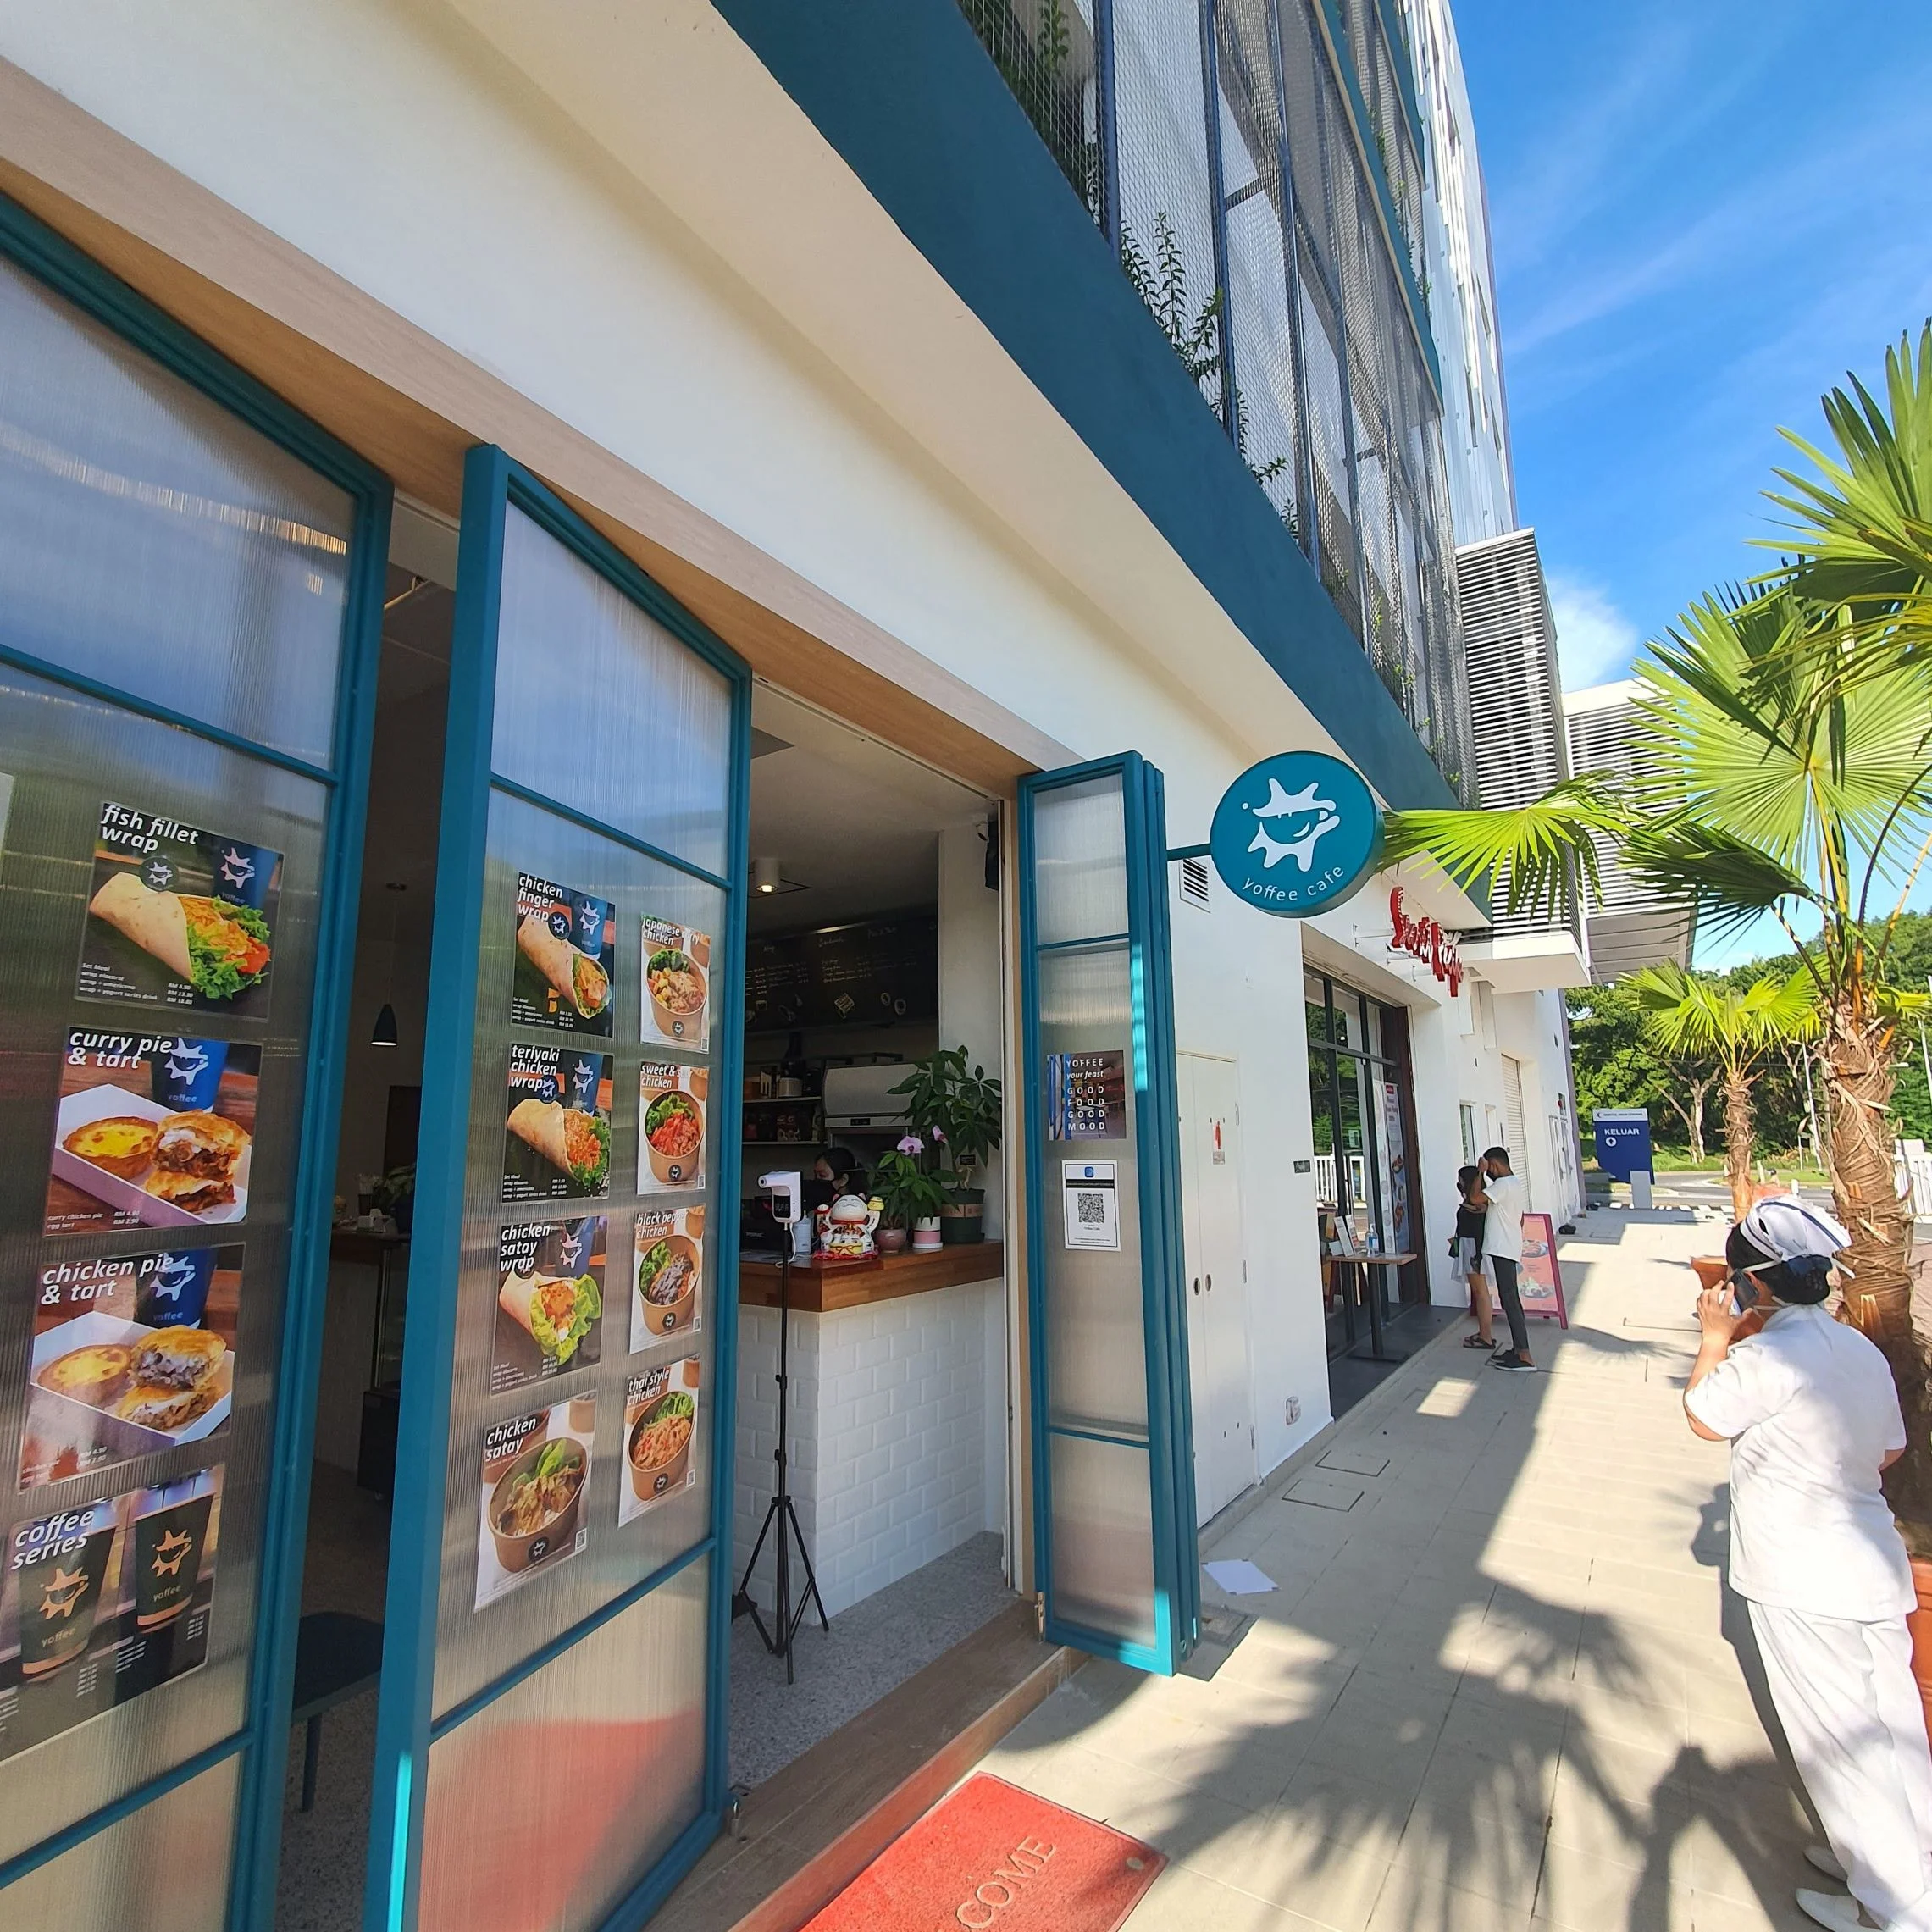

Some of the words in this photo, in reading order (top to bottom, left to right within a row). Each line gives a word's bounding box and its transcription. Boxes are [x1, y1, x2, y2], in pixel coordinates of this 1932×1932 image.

[101, 805, 144, 830] fish
[147, 818, 199, 844] fillet
[102, 826, 158, 854] wrap
[519, 874, 562, 899] chicken
[1243, 877, 1298, 901] yoffee
[1307, 866, 1344, 896] cafe
[517, 887, 555, 909] finger
[518, 904, 549, 922] wrap
[642, 915, 680, 937] japanese
[643, 928, 673, 946] chicken
[69, 1032, 133, 1055] curry
[137, 1036, 173, 1056] pie
[68, 1047, 87, 1066] &
[97, 1050, 142, 1069] tart
[512, 1044, 560, 1063] teriyaki
[1066, 1058, 1104, 1067] YOFFEE
[511, 1059, 557, 1077] chicken
[642, 1065, 667, 1077] sweet
[669, 1065, 675, 1077] &
[1083, 1071, 1104, 1080] feast
[511, 1076, 542, 1092] wrap
[641, 1076, 673, 1088] chicken
[1067, 1086, 1104, 1095] GOOD
[169, 1094, 197, 1103] yoffee
[1067, 1110, 1104, 1119] GOOD
[1068, 1122, 1105, 1131] MOOD
[637, 1212, 662, 1226] black
[501, 1223, 551, 1241] chicken
[637, 1226, 667, 1239] chicken
[501, 1241, 538, 1257] satay
[42, 1259, 134, 1285] chicken
[139, 1253, 174, 1278] pie
[501, 1256, 534, 1272] wrap
[41, 1285, 61, 1305] &
[71, 1279, 117, 1301] tart
[628, 1377, 648, 1392] thai
[650, 1367, 670, 1386] style
[628, 1386, 661, 1406] chicken
[487, 1418, 537, 1446] chicken
[485, 1437, 524, 1462] satay
[15, 1509, 95, 1547] coffee
[11, 1532, 90, 1570] series
[152, 1585, 181, 1603] yoffee
[42, 1626, 76, 1647] yoffee
